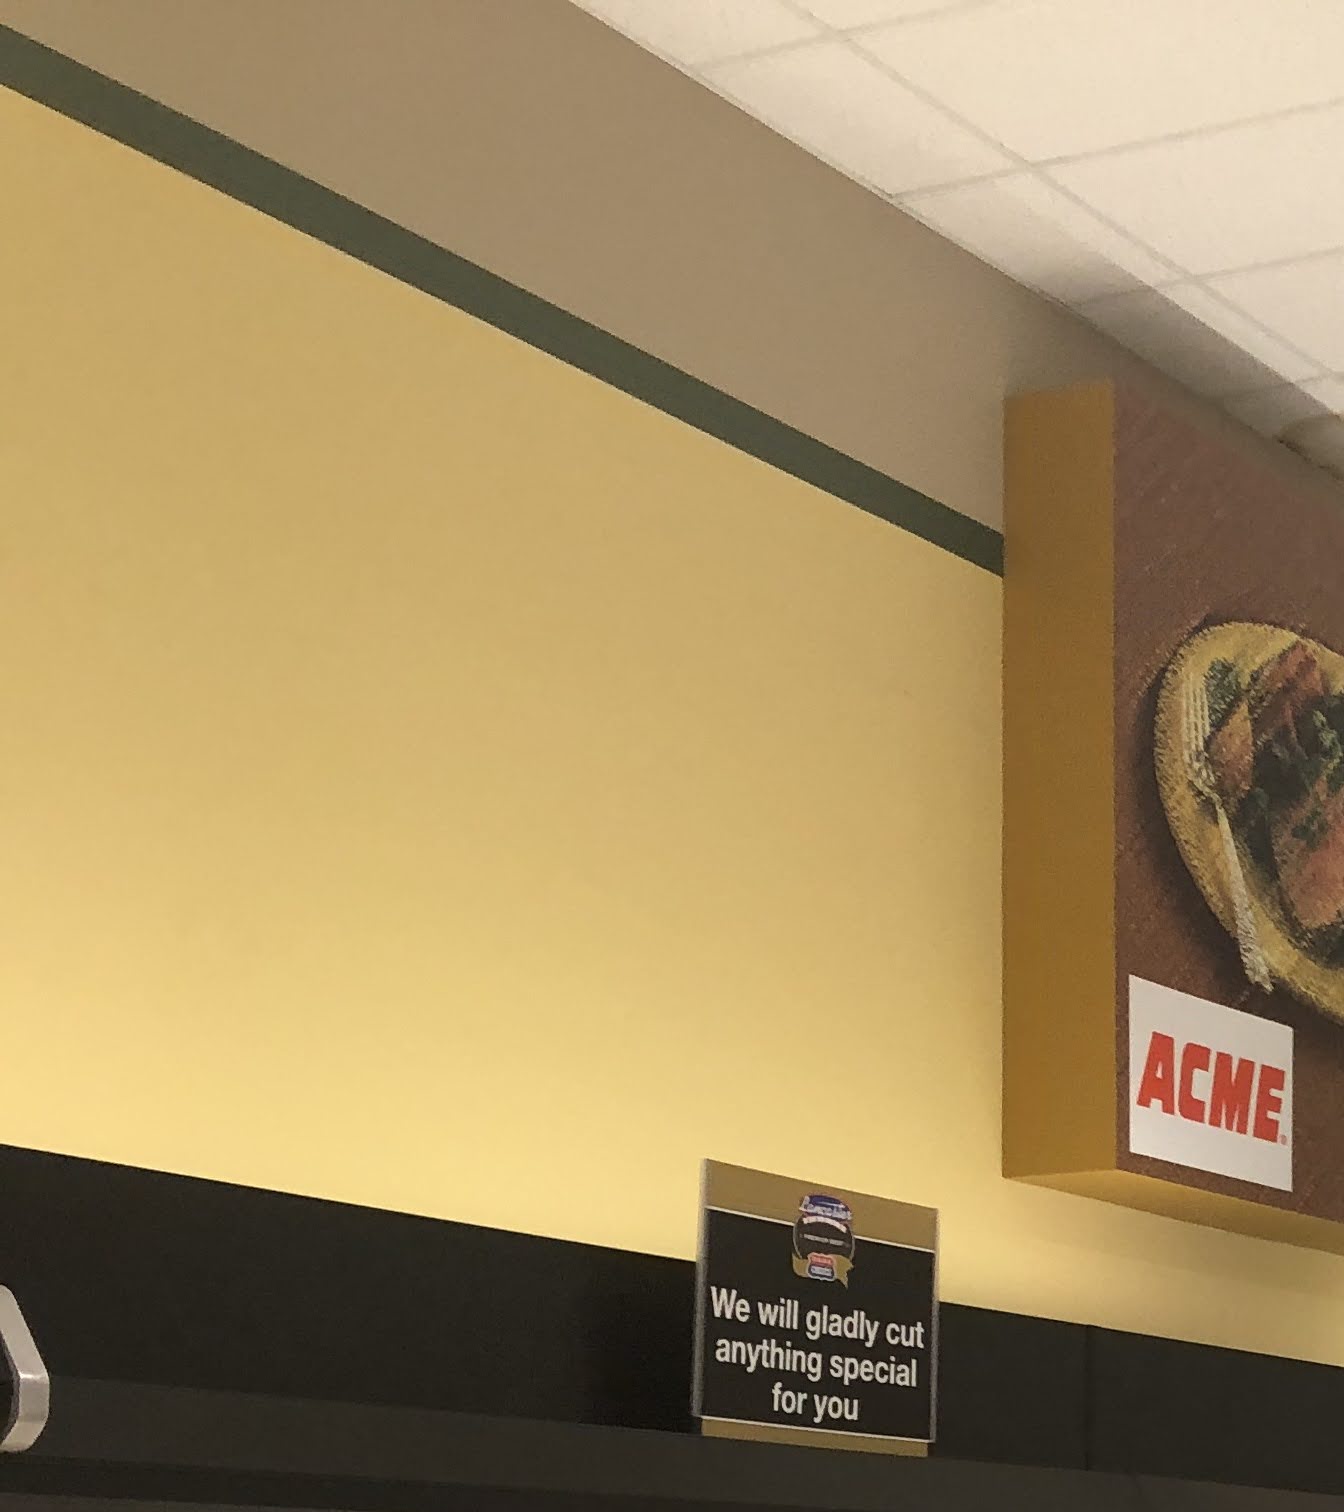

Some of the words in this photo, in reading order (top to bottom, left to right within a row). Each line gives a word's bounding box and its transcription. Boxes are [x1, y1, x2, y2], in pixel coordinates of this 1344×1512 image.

[1137, 1031, 1286, 1144] ACME
[710, 1286, 750, 1322] We
[757, 1297, 799, 1330] will
[805, 1305, 880, 1348] gladly
[885, 1320, 925, 1349] cut
[715, 1338, 822, 1382] anything
[829, 1356, 917, 1387] special
[771, 1381, 808, 1414] for
[813, 1393, 860, 1424] you
